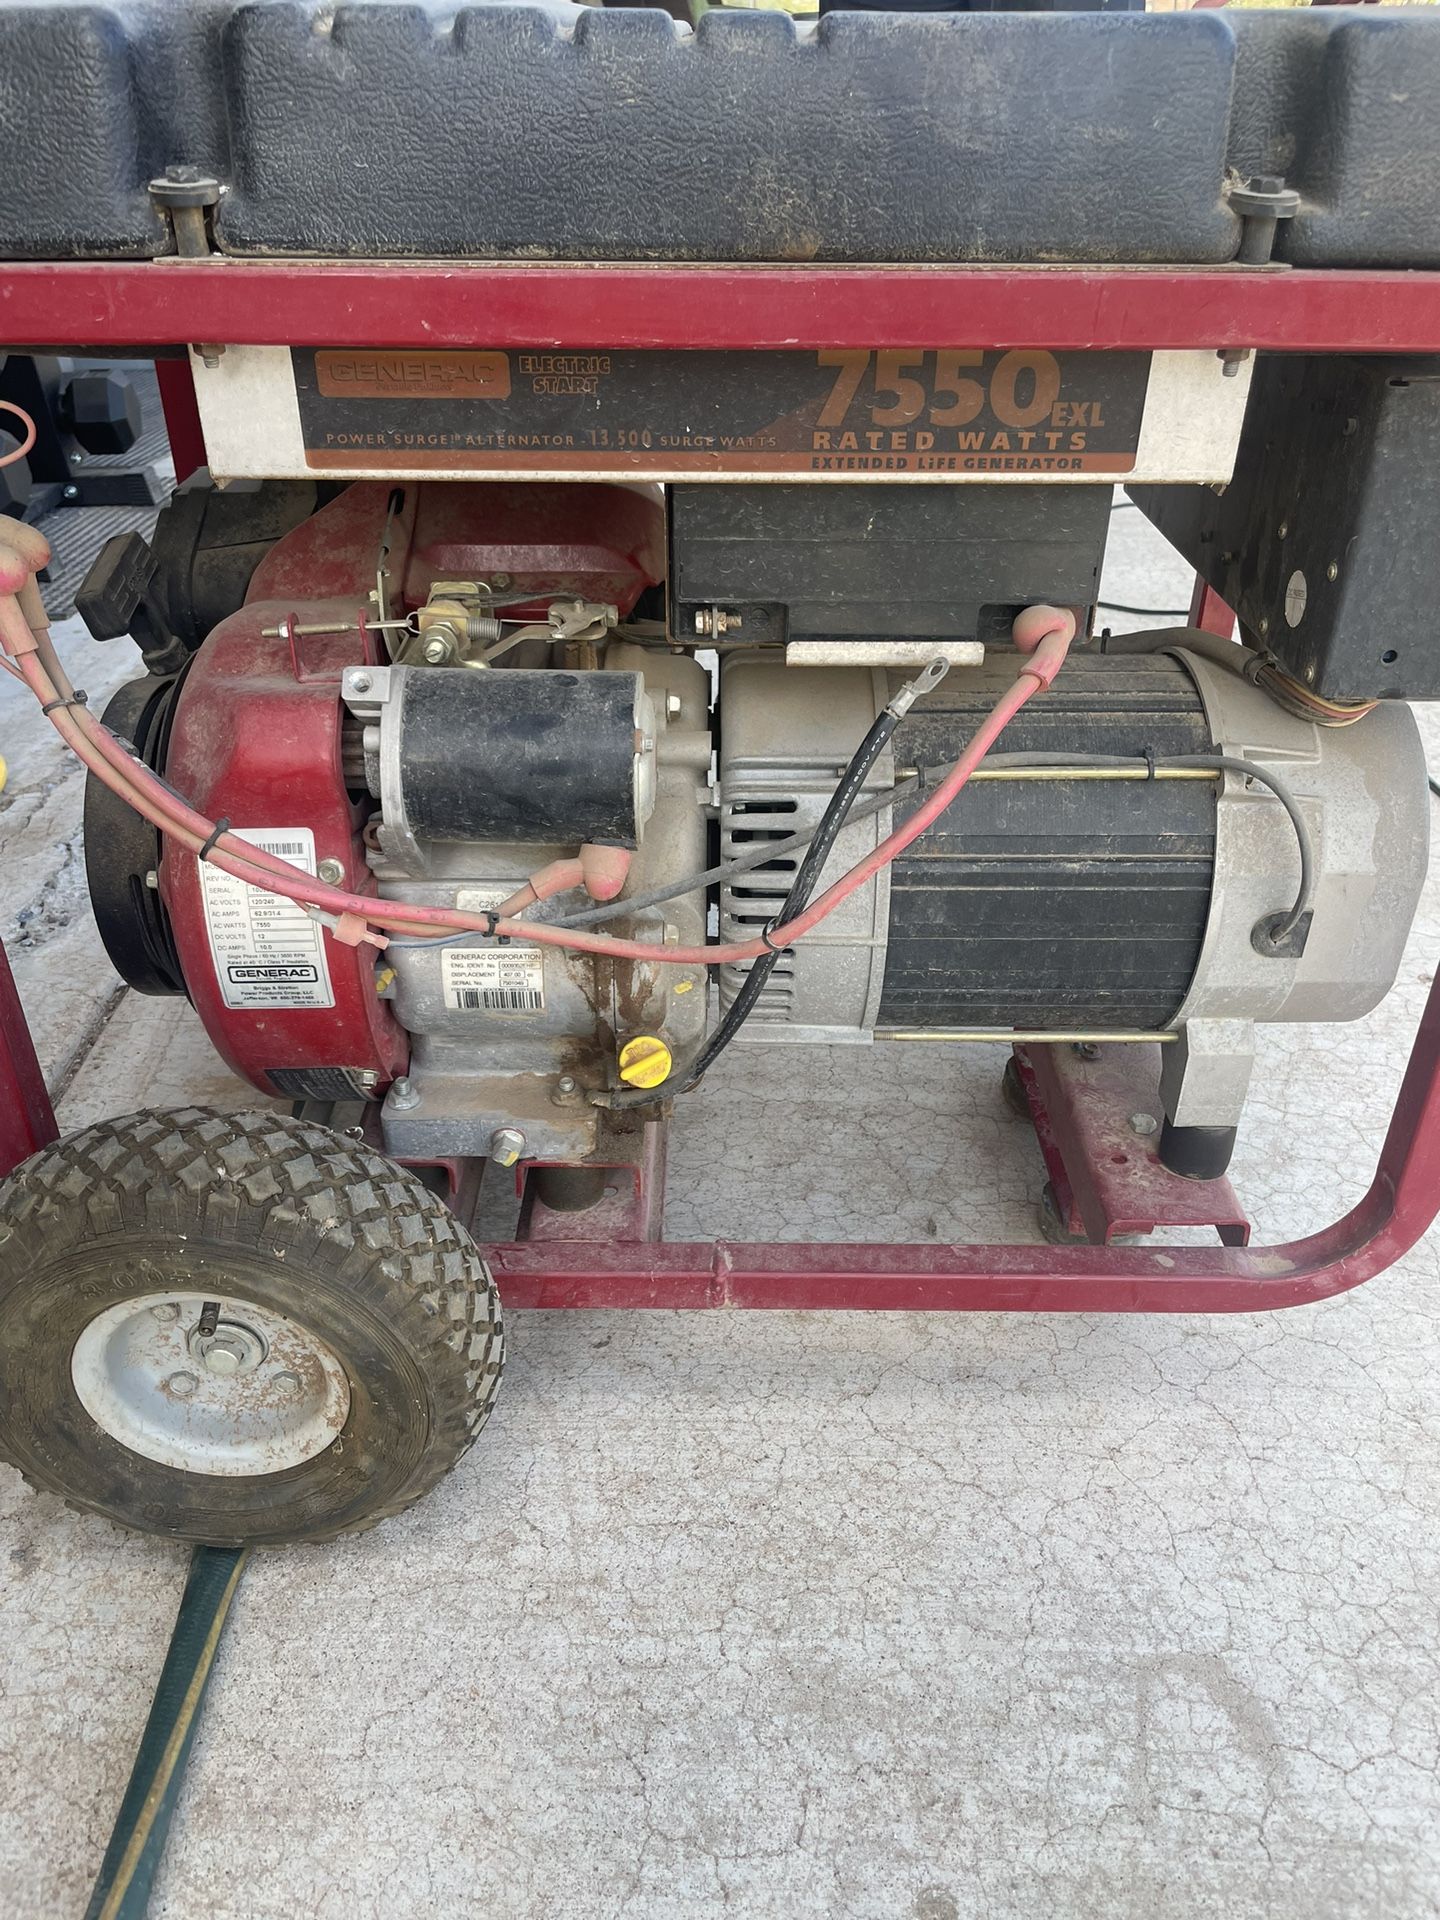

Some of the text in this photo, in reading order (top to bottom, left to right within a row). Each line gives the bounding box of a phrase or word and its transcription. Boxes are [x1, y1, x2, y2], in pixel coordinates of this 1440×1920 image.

[329, 361, 495, 382] GENERAC
[519, 355, 611, 374] ELECTRIC
[532, 376, 598, 395] START
[815, 349, 1061, 428] 7550
[1051, 401, 1105, 428] EXL
[326, 433, 386, 446] POWER
[465, 433, 575, 446] ALTERNATOR
[590, 429, 651, 449] 13,500
[660, 435, 713, 447] SURGE
[719, 435, 777, 447] WATTS
[813, 431, 1087, 451] RATED WATTS
[811, 457, 908, 470] EXTENDED
[963, 457, 1083, 470] GENERATOR
[235, 968, 310, 977] GENERAC
